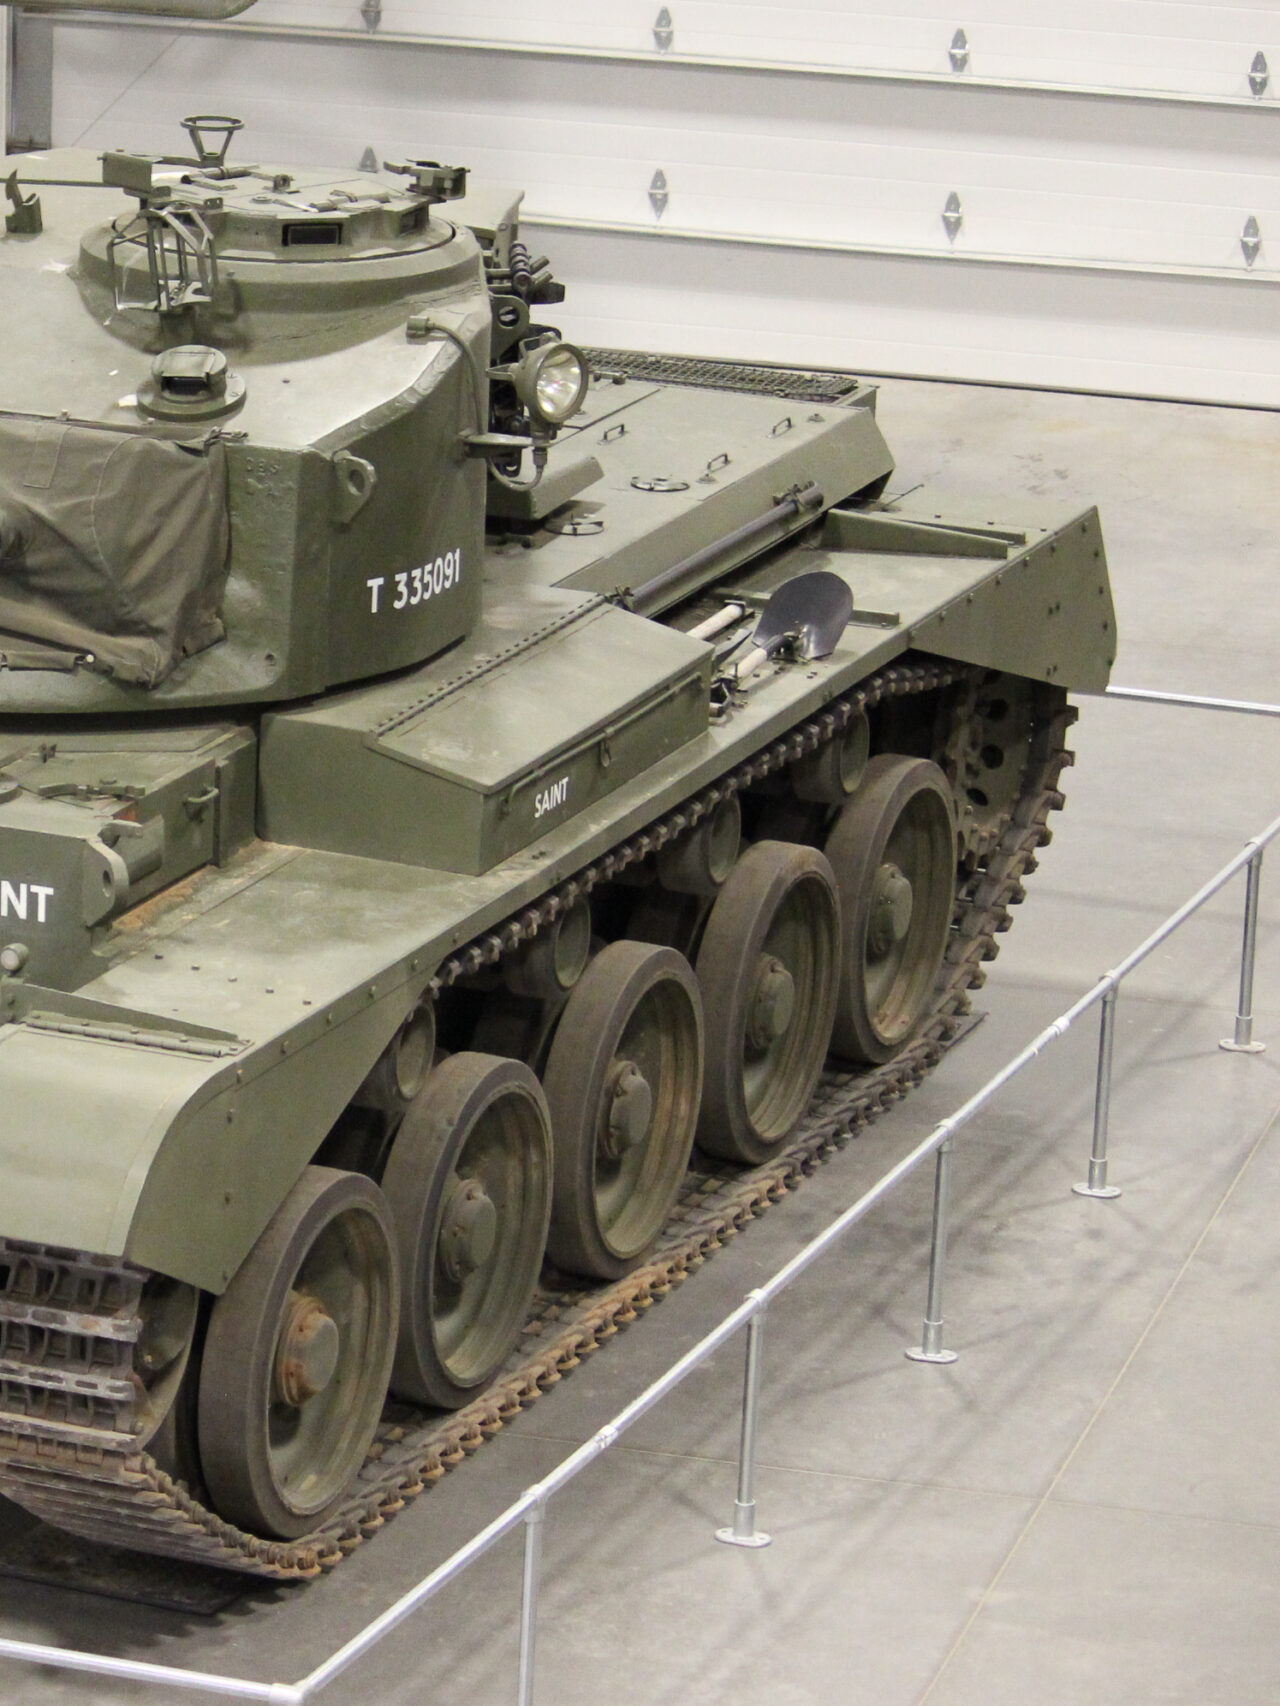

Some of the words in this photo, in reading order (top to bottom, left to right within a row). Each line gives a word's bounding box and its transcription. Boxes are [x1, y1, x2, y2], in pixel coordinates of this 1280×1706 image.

[366, 577, 384, 613] T
[393, 548, 460, 609] 335091
[534, 776, 569, 818] SAINT
